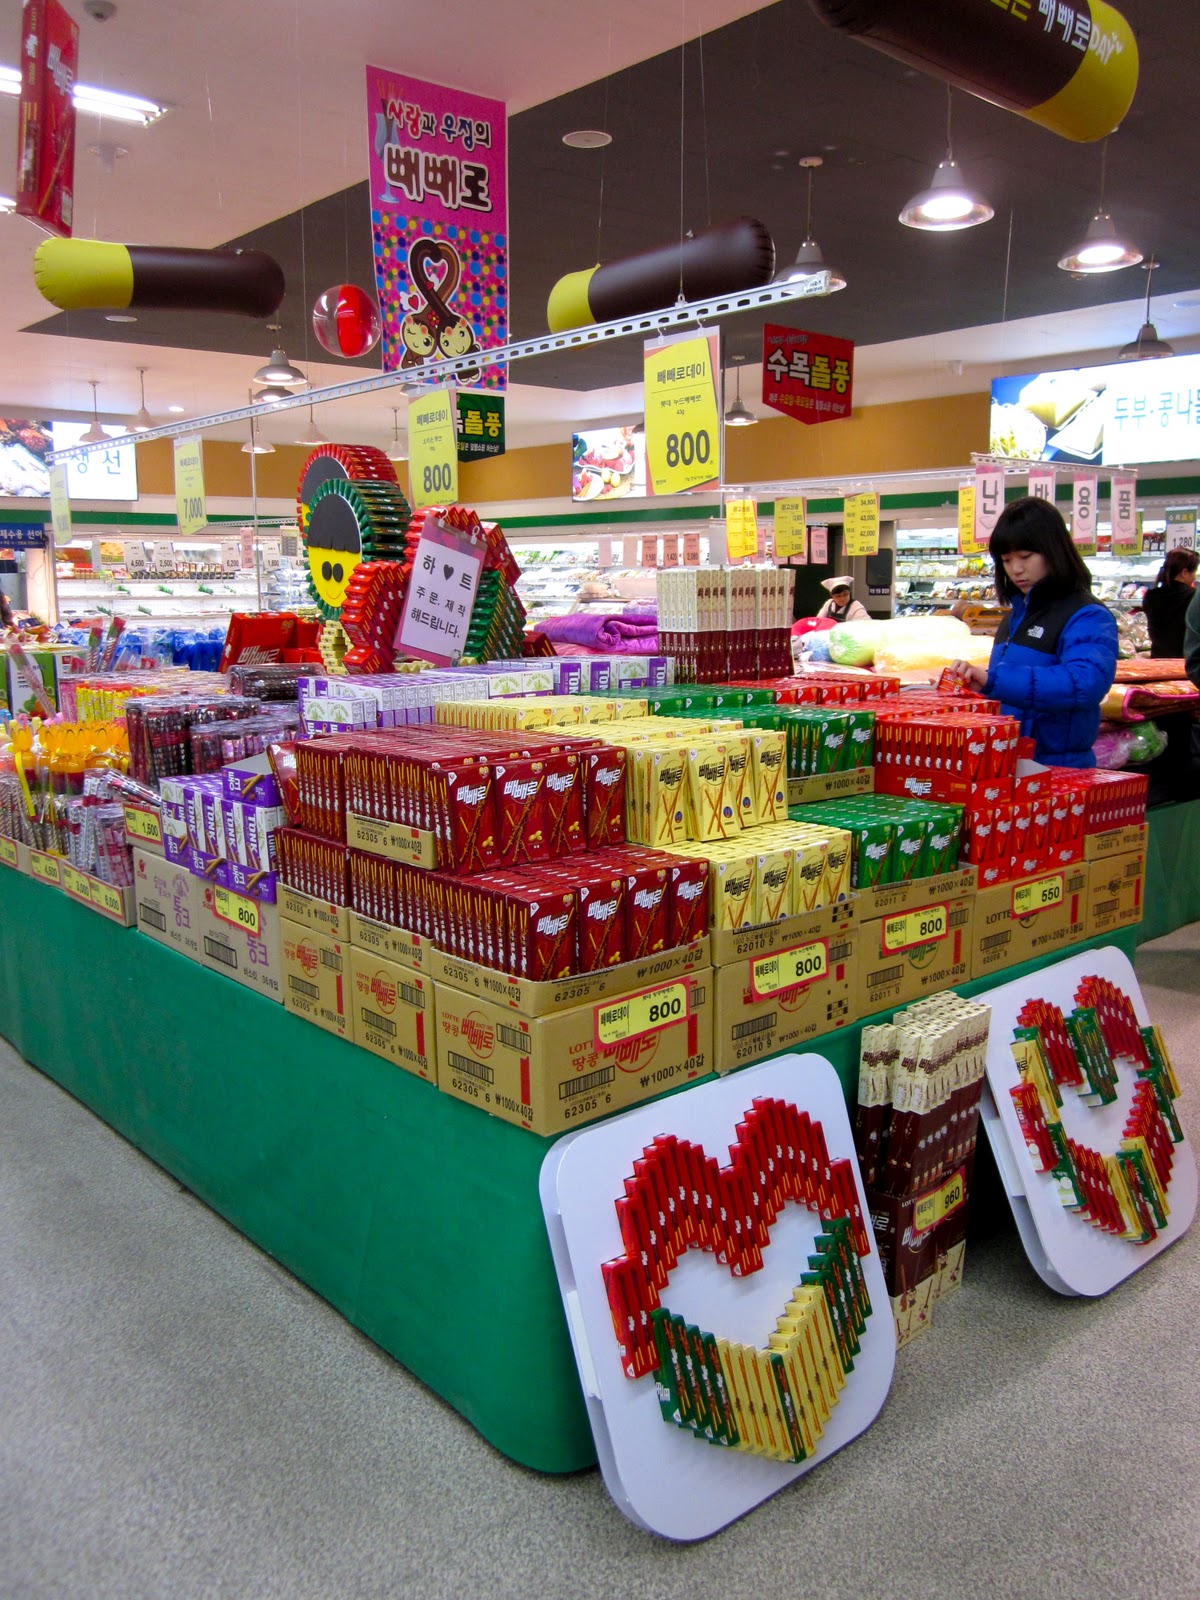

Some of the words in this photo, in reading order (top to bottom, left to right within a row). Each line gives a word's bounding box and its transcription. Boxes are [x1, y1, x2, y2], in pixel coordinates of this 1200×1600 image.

[387, 99, 436, 139] 사랑과
[440, 112, 492, 151] 우정의
[383, 142, 493, 212] 빼빼로
[657, 362, 705, 384] 빼빼로데이
[767, 348, 850, 394] 수목돌풍
[416, 409, 448, 426] 빼빼로데이
[666, 429, 710, 468] 800
[423, 462, 452, 493] 800
[183, 498, 203, 522] 7,000
[411, 607, 460, 638] 해드립니다.
[547, 773, 573, 792] 빼빼로
[596, 768, 620, 786] 빼빼로
[457, 785, 487, 805] 빼빼로
[504, 780, 538, 799] 빼빼로
[357, 830, 378, 843] 62305
[634, 889, 662, 909] 빼빼로
[677, 881, 703, 899] 빼빼로
[1041, 886, 1060, 902] 550
[238, 907, 256, 926] 800
[588, 900, 617, 920] 빼빼로
[537, 914, 568, 935] 빼빼로
[920, 918, 942, 936] 800
[359, 931, 380, 946] 62305
[737, 940, 765, 954] 62010
[795, 955, 822, 976] 800
[443, 965, 469, 982] 62305
[474, 977, 480, 987] 6
[555, 986, 590, 1002] 62305
[599, 982, 605, 991] 6
[649, 998, 681, 1023] 800
[365, 1032, 386, 1049] 62305
[460, 1017, 495, 1050] 빼빼로
[569, 1040, 594, 1055] LOTT
[736, 1043, 763, 1059] 62010
[452, 1078, 478, 1098] 62305
[485, 1093, 490, 1103] 6
[564, 1100, 597, 1119] 62305
[606, 1094, 611, 1103] 6
[944, 1186, 960, 1209] 960
